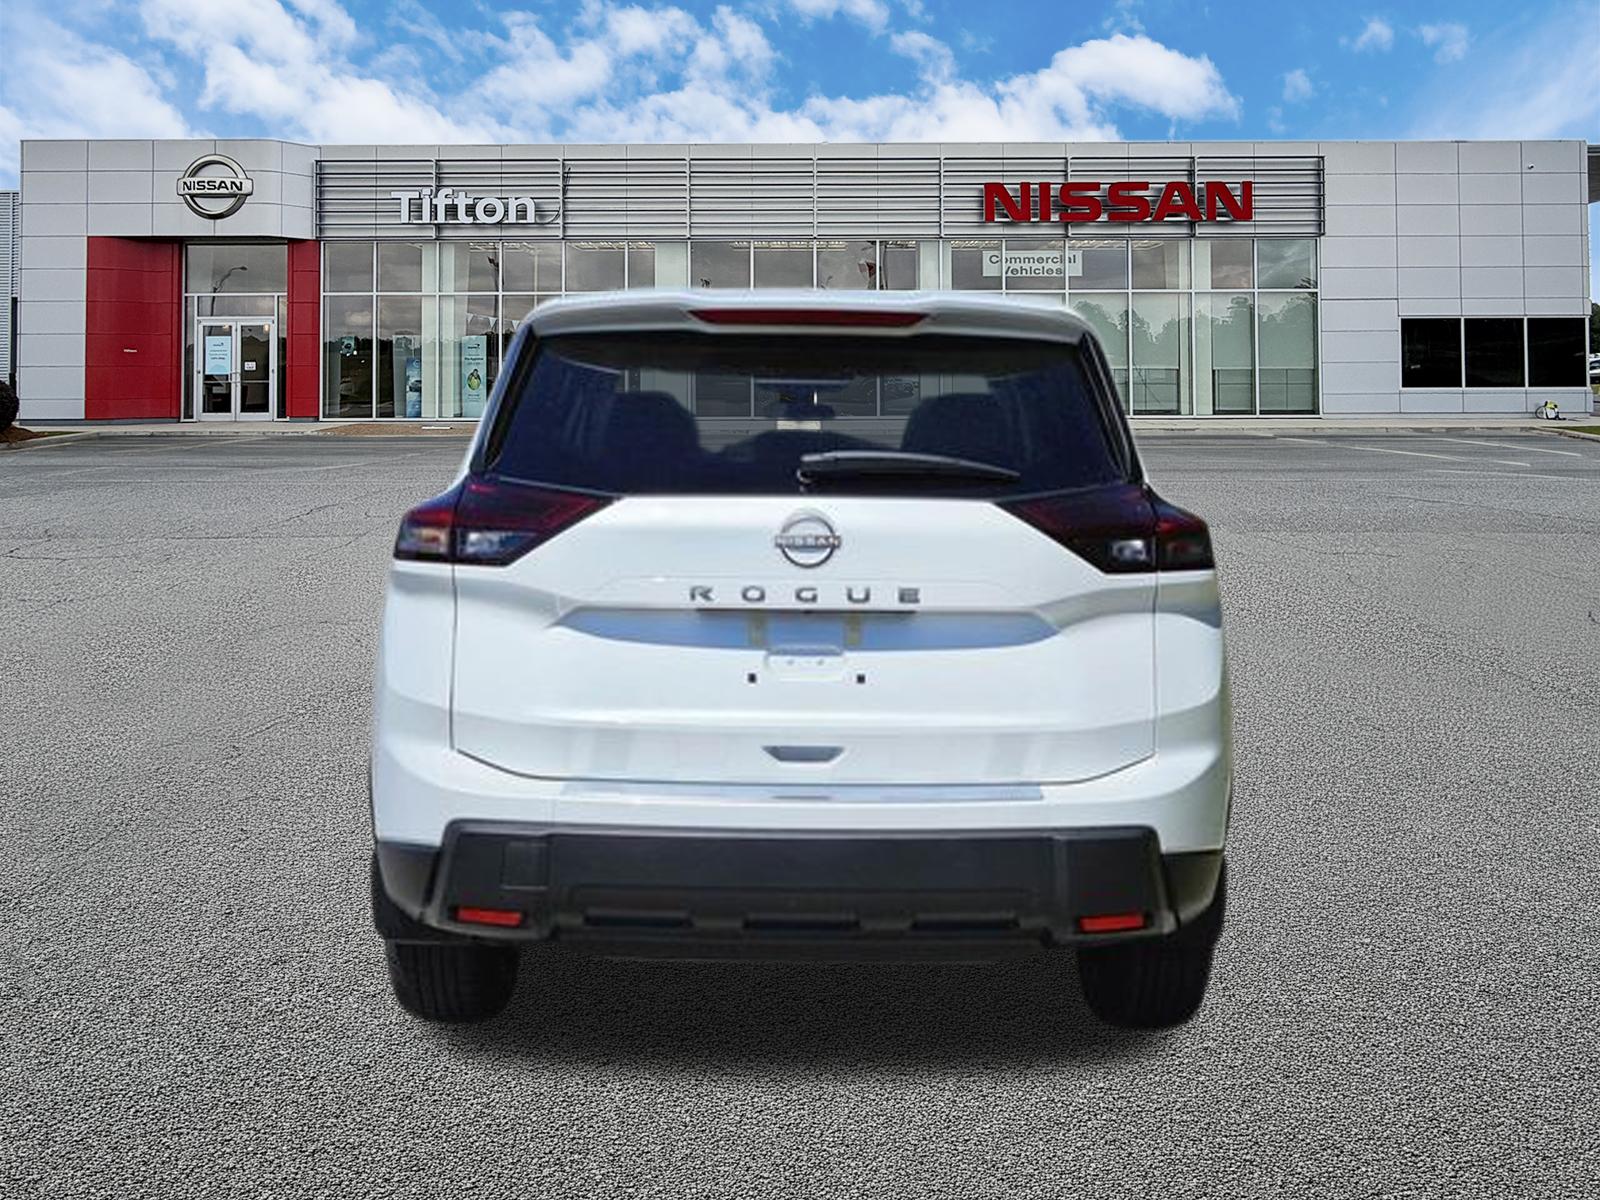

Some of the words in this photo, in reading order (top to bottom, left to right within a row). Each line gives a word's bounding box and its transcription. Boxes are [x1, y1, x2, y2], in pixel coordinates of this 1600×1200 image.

[183, 180, 243, 191] NISSAN
[391, 188, 536, 224] Tifton
[984, 181, 1253, 222] NISSAN
[775, 535, 841, 549] NISSAN
[689, 585, 920, 604] ROGUE
